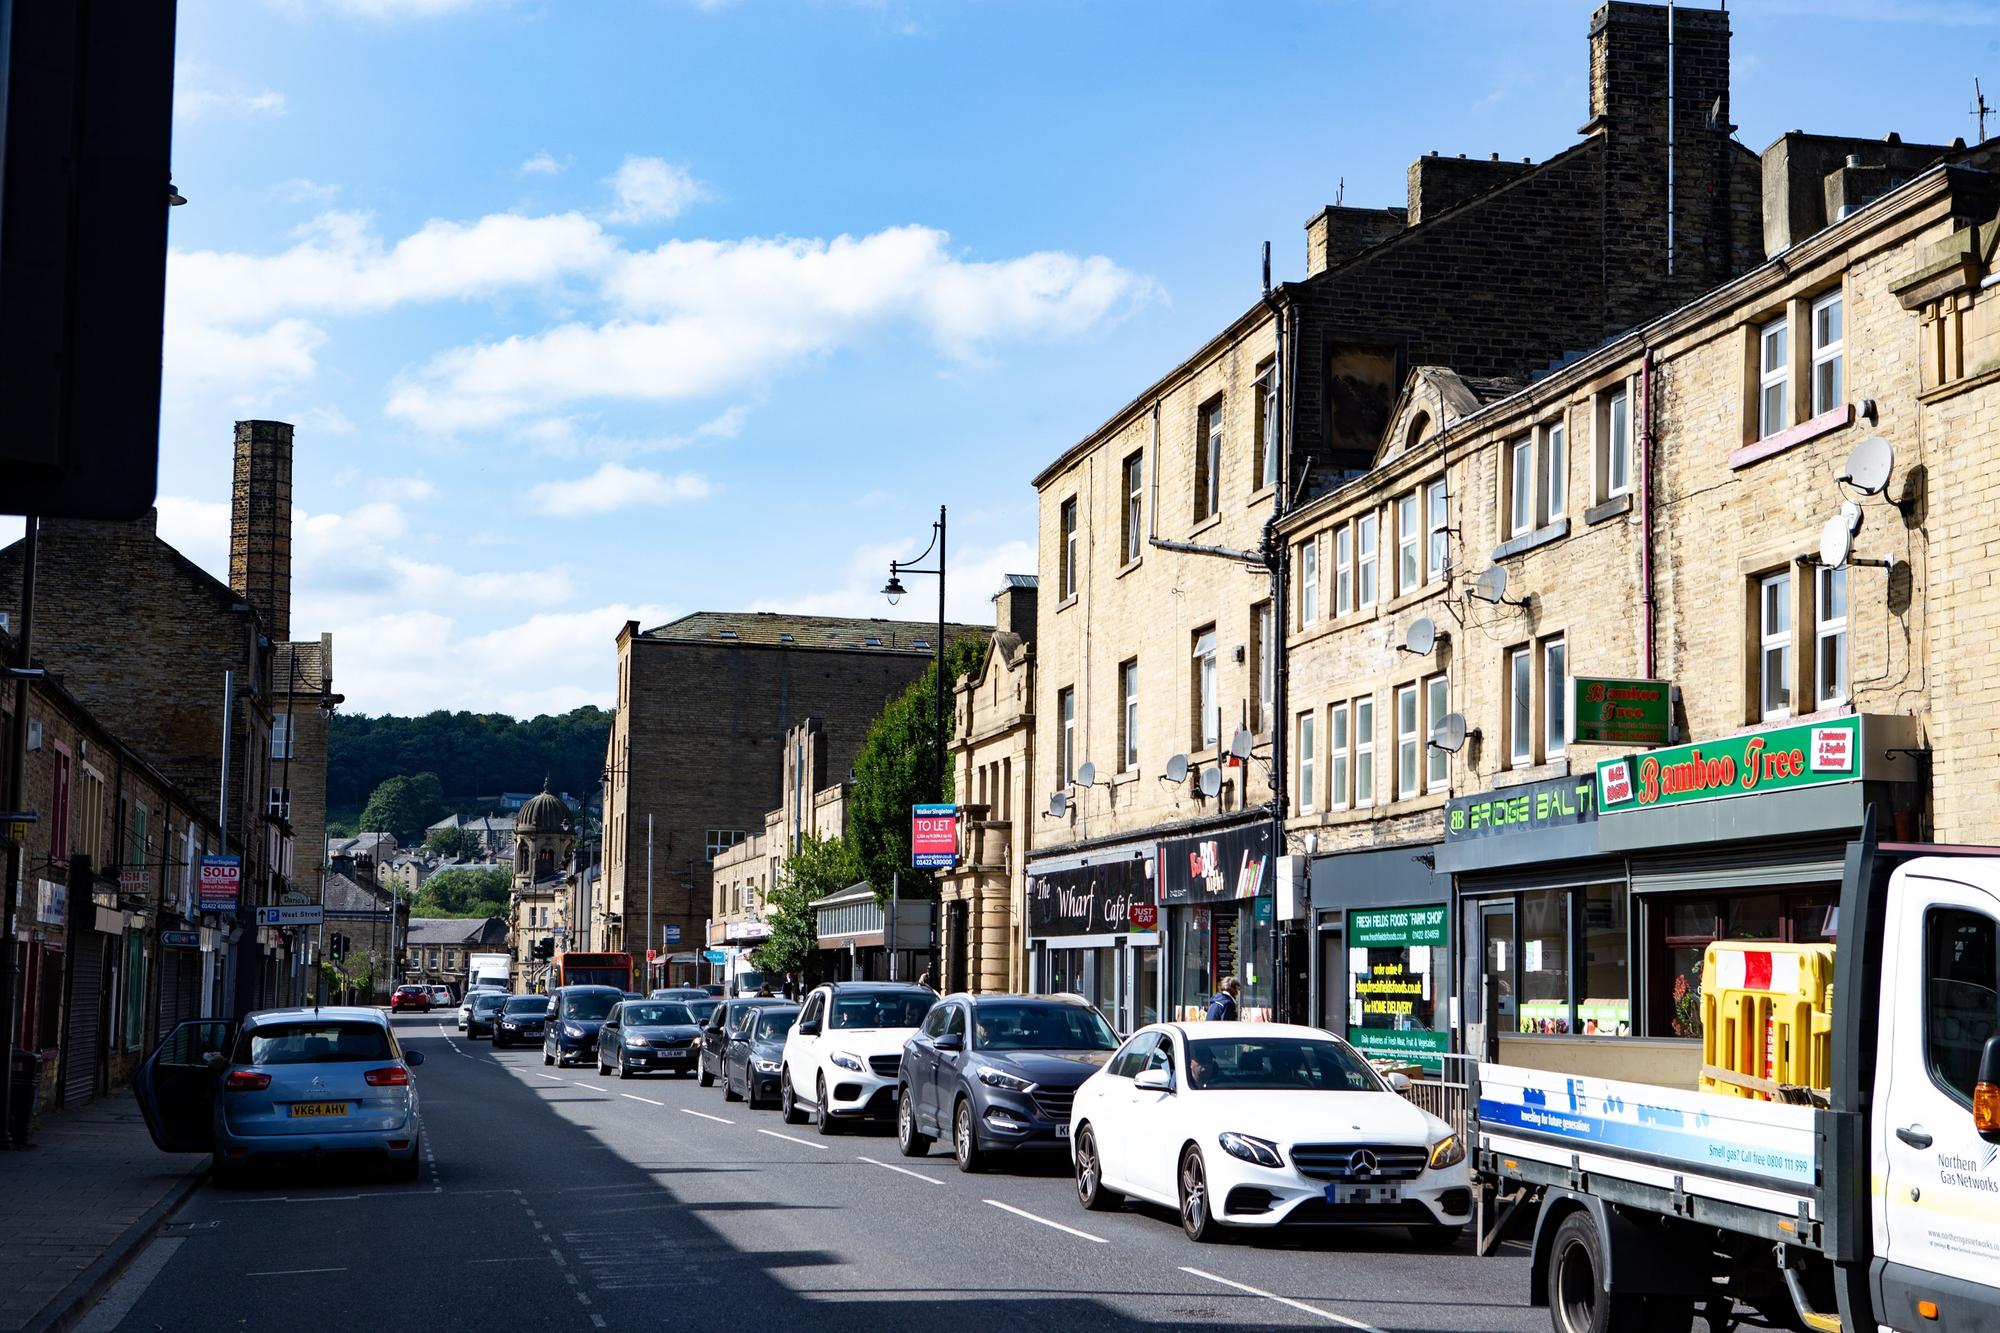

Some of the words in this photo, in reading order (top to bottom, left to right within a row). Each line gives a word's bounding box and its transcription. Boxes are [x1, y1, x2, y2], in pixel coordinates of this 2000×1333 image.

[1585, 682, 1660, 703] Bamboo
[1600, 702, 1644, 721] Tree
[1638, 749, 1736, 804] Bamboo
[1741, 736, 1804, 789] Tree
[1469, 795, 1530, 829] BRIDGE
[917, 820, 931, 831] TO
[933, 820, 950, 831] LET
[121, 872, 139, 881] ISH
[203, 867, 237, 877] SOLD
[121, 883, 147, 892] HIPS
[1037, 876, 1051, 900] The
[1056, 880, 1096, 932] Wharf
[1104, 894, 1125, 930] Café
[1134, 908, 1154, 916] JUST
[1356, 916, 1371, 928] FRESH
[1372, 914, 1389, 928] FIELDS
[1390, 913, 1408, 927] FOODS
[1371, 1000, 1386, 1013] HOME
[1387, 1000, 1413, 1015] DELIVERY
[294, 1105, 321, 1115] VK64
[324, 1104, 345, 1114] AHV
[1709, 1144, 1725, 1158] Smell
[1726, 1149, 1739, 1162] gas?
[1741, 1150, 1752, 1162] Call
[1753, 1152, 1765, 1166] free
[1767, 1155, 1782, 1168] 0800
[1784, 1158, 1794, 1170] 111
[1796, 1160, 1808, 1172] 999
[1938, 1153, 1977, 1172] Northern
[1940, 1170, 1956, 1186] Gas
[1956, 1173, 1999, 1193] Networks
